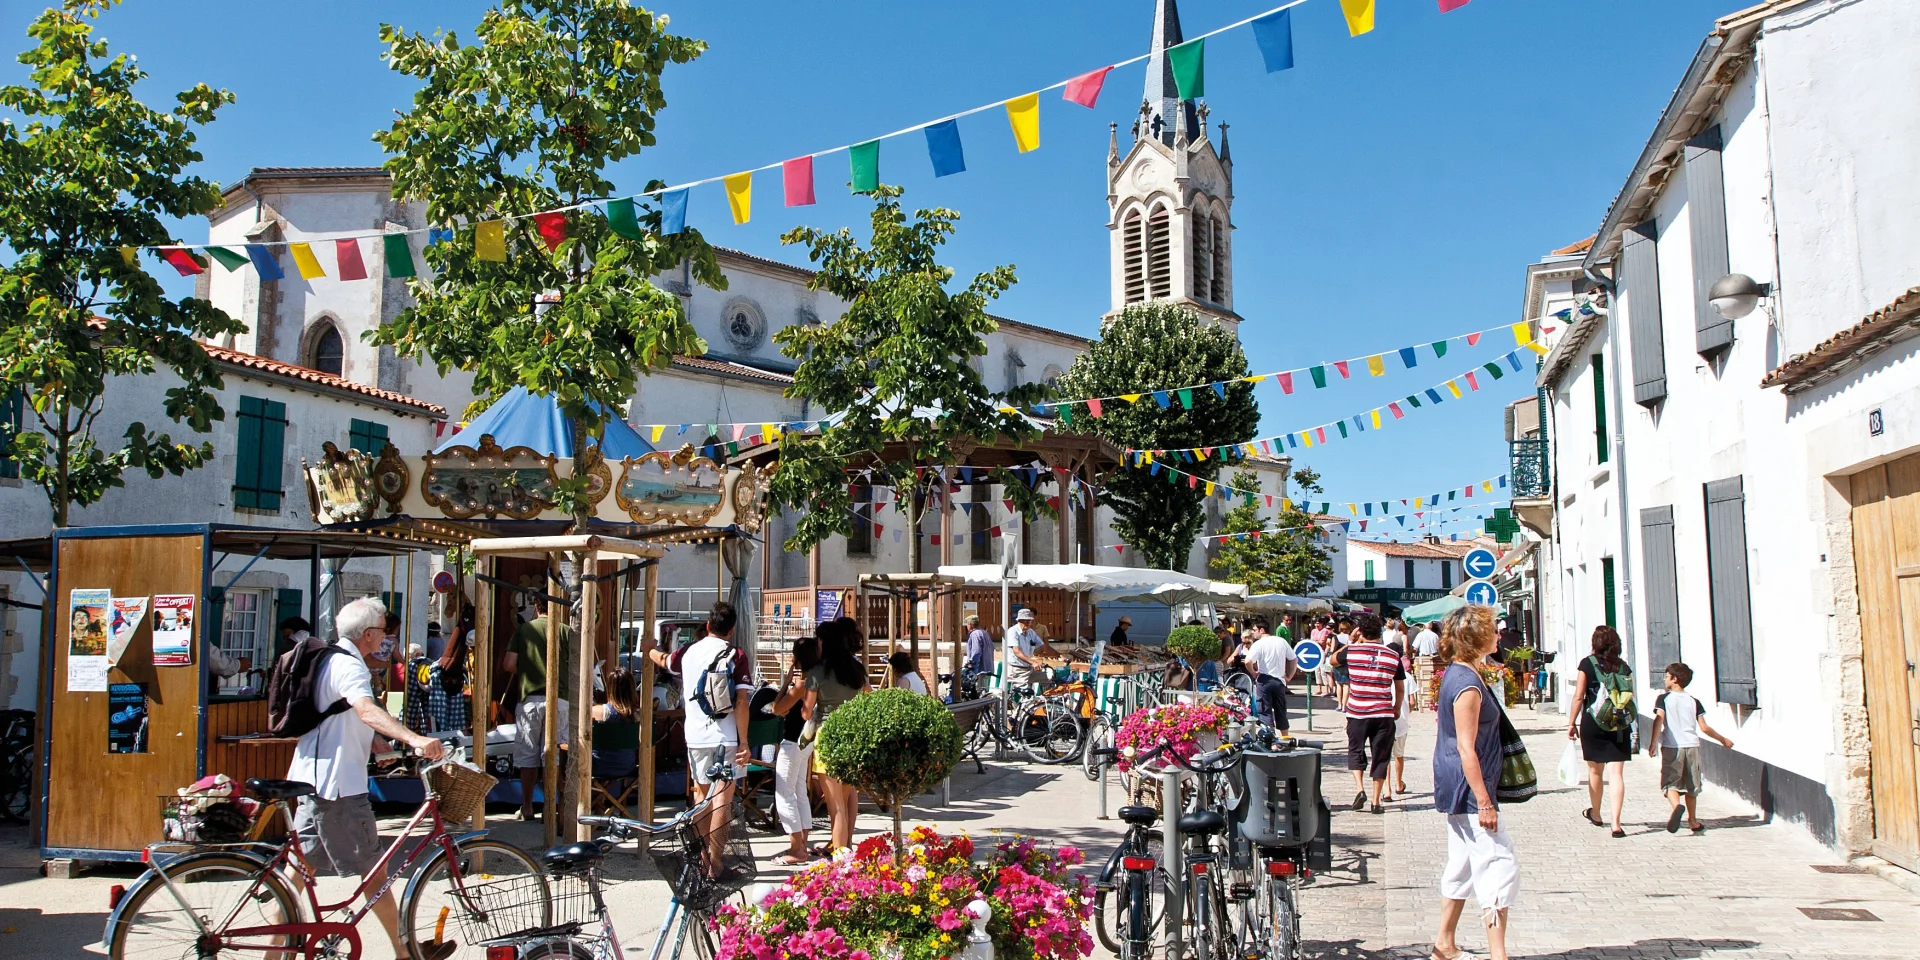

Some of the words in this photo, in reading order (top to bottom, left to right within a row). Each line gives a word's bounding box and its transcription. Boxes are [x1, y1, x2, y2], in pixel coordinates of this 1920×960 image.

[1870, 412, 1881, 433] 18
[1400, 592, 1408, 600] AU
[1409, 592, 1423, 600] PAIN
[1425, 592, 1445, 600] MARIN
[364, 867, 404, 910] PEUGEOT
